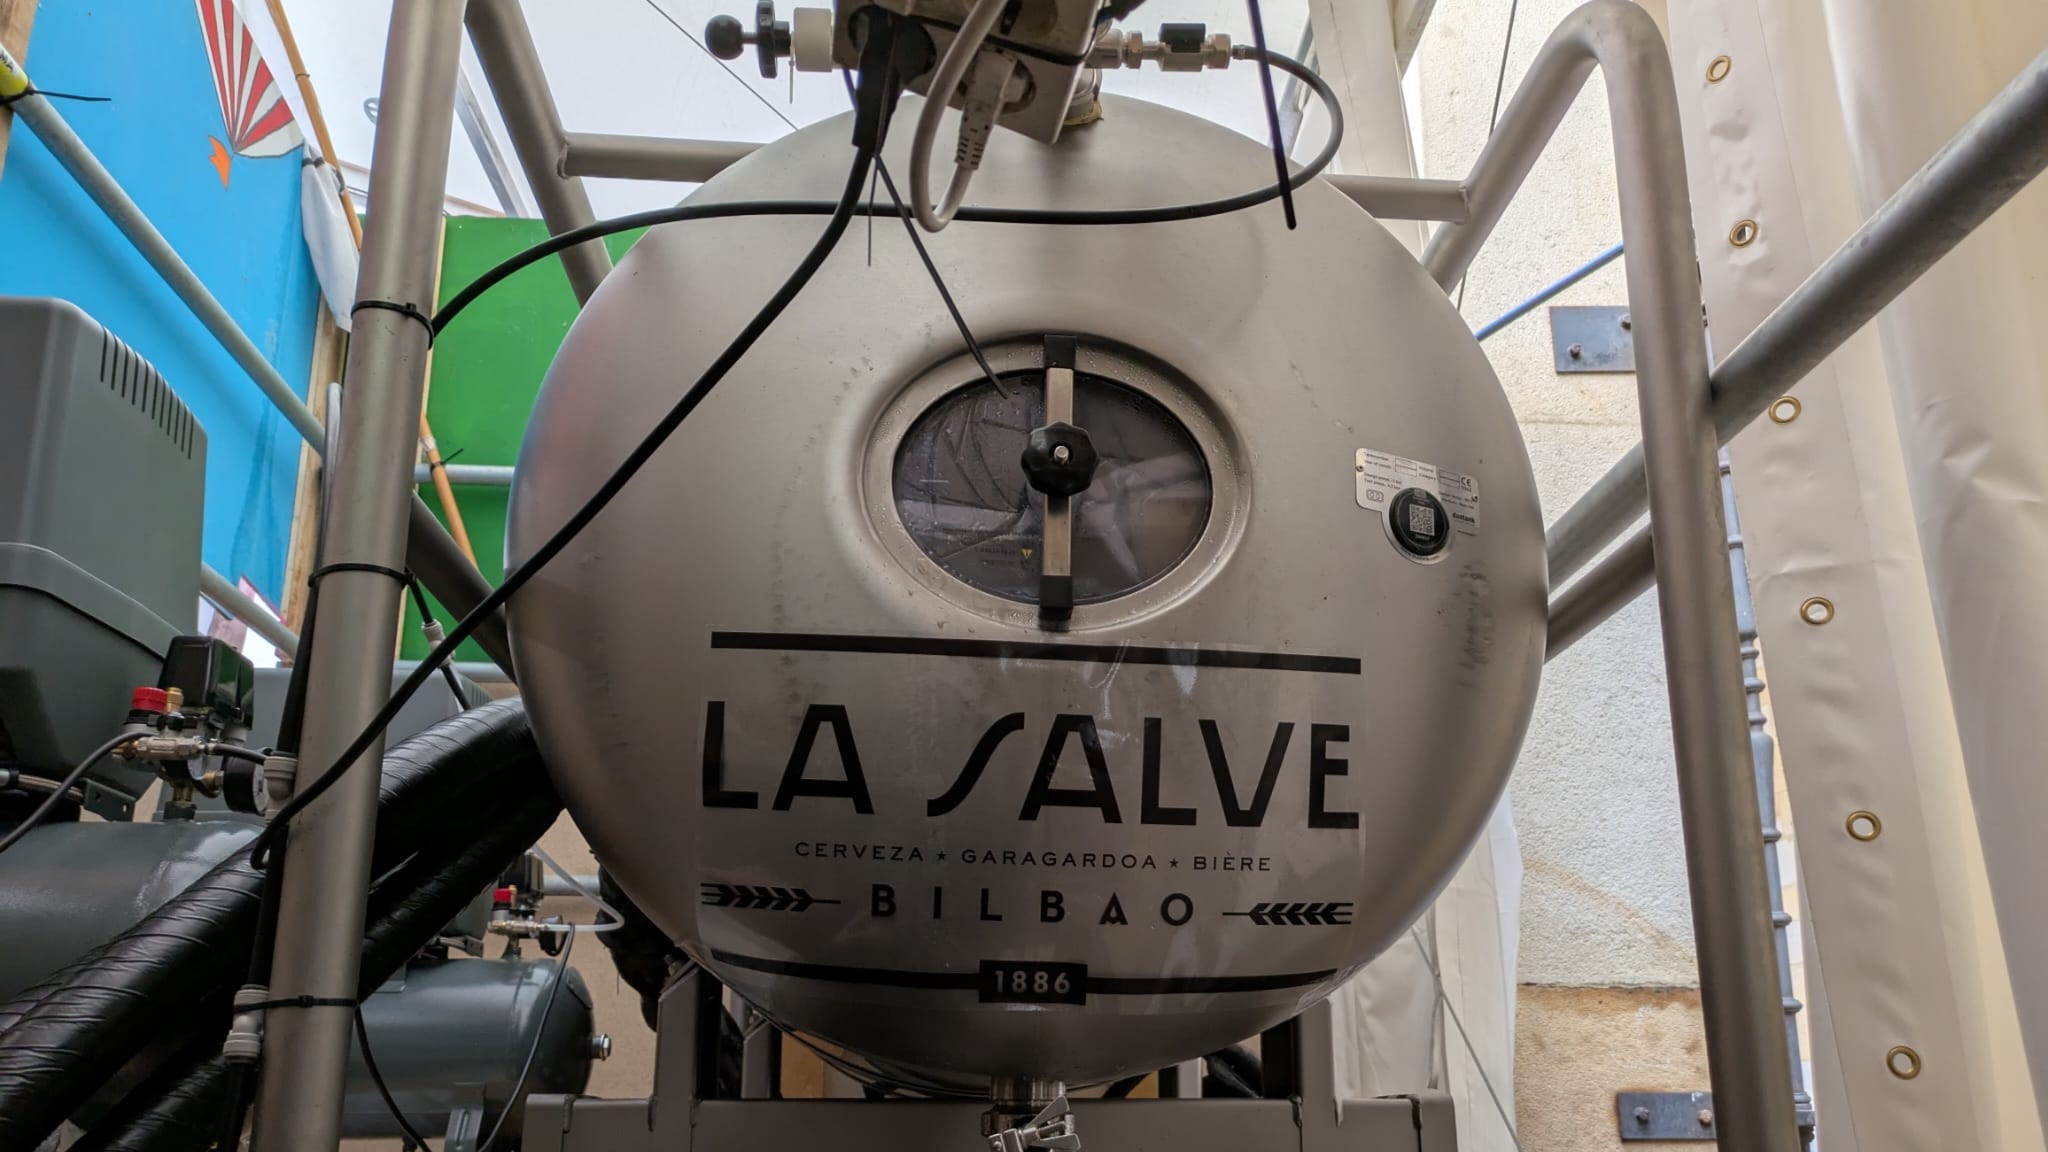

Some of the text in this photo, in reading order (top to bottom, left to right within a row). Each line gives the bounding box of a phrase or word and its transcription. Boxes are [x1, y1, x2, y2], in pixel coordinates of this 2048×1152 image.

[702, 701, 1360, 829] LA SALVE
[795, 842, 1272, 872] CERVEZA GARAGARDOA BIÈRE
[871, 883, 1195, 927] BILBAO
[994, 970, 1071, 995] 1886
